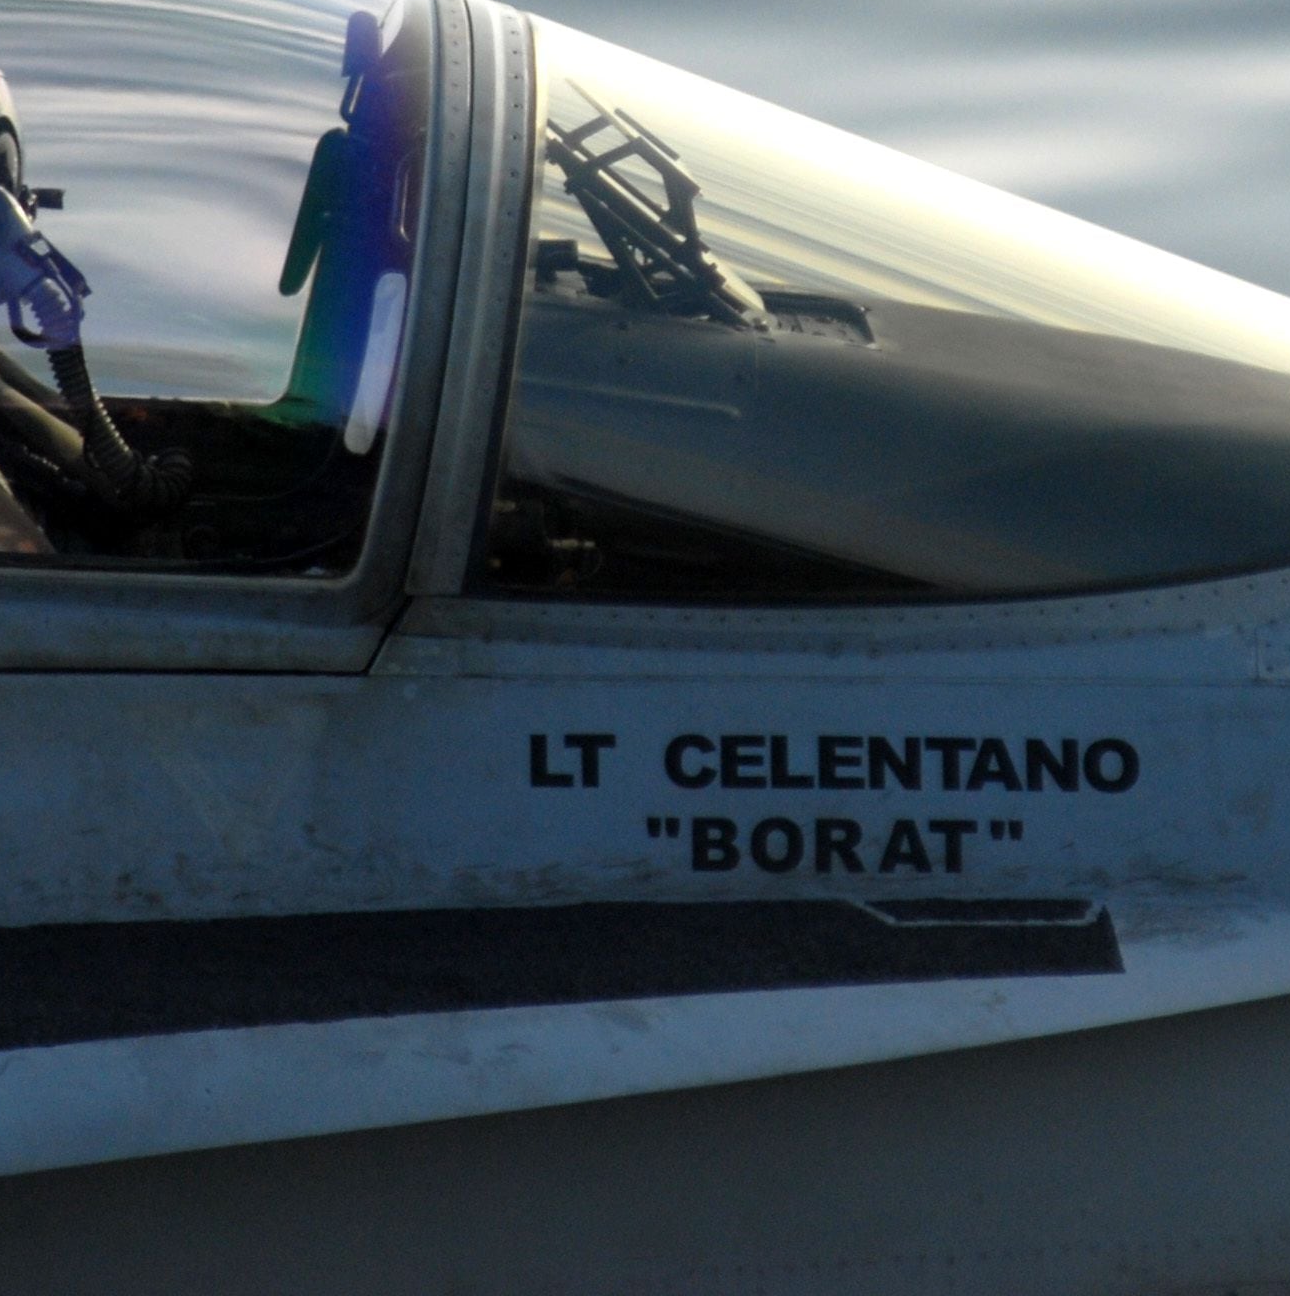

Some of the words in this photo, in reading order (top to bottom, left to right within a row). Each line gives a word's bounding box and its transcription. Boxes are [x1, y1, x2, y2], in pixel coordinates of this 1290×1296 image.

[529, 734, 616, 788] LT
[664, 735, 1140, 793] CELENTANO
[646, 816, 1024, 874] "BORAT"
